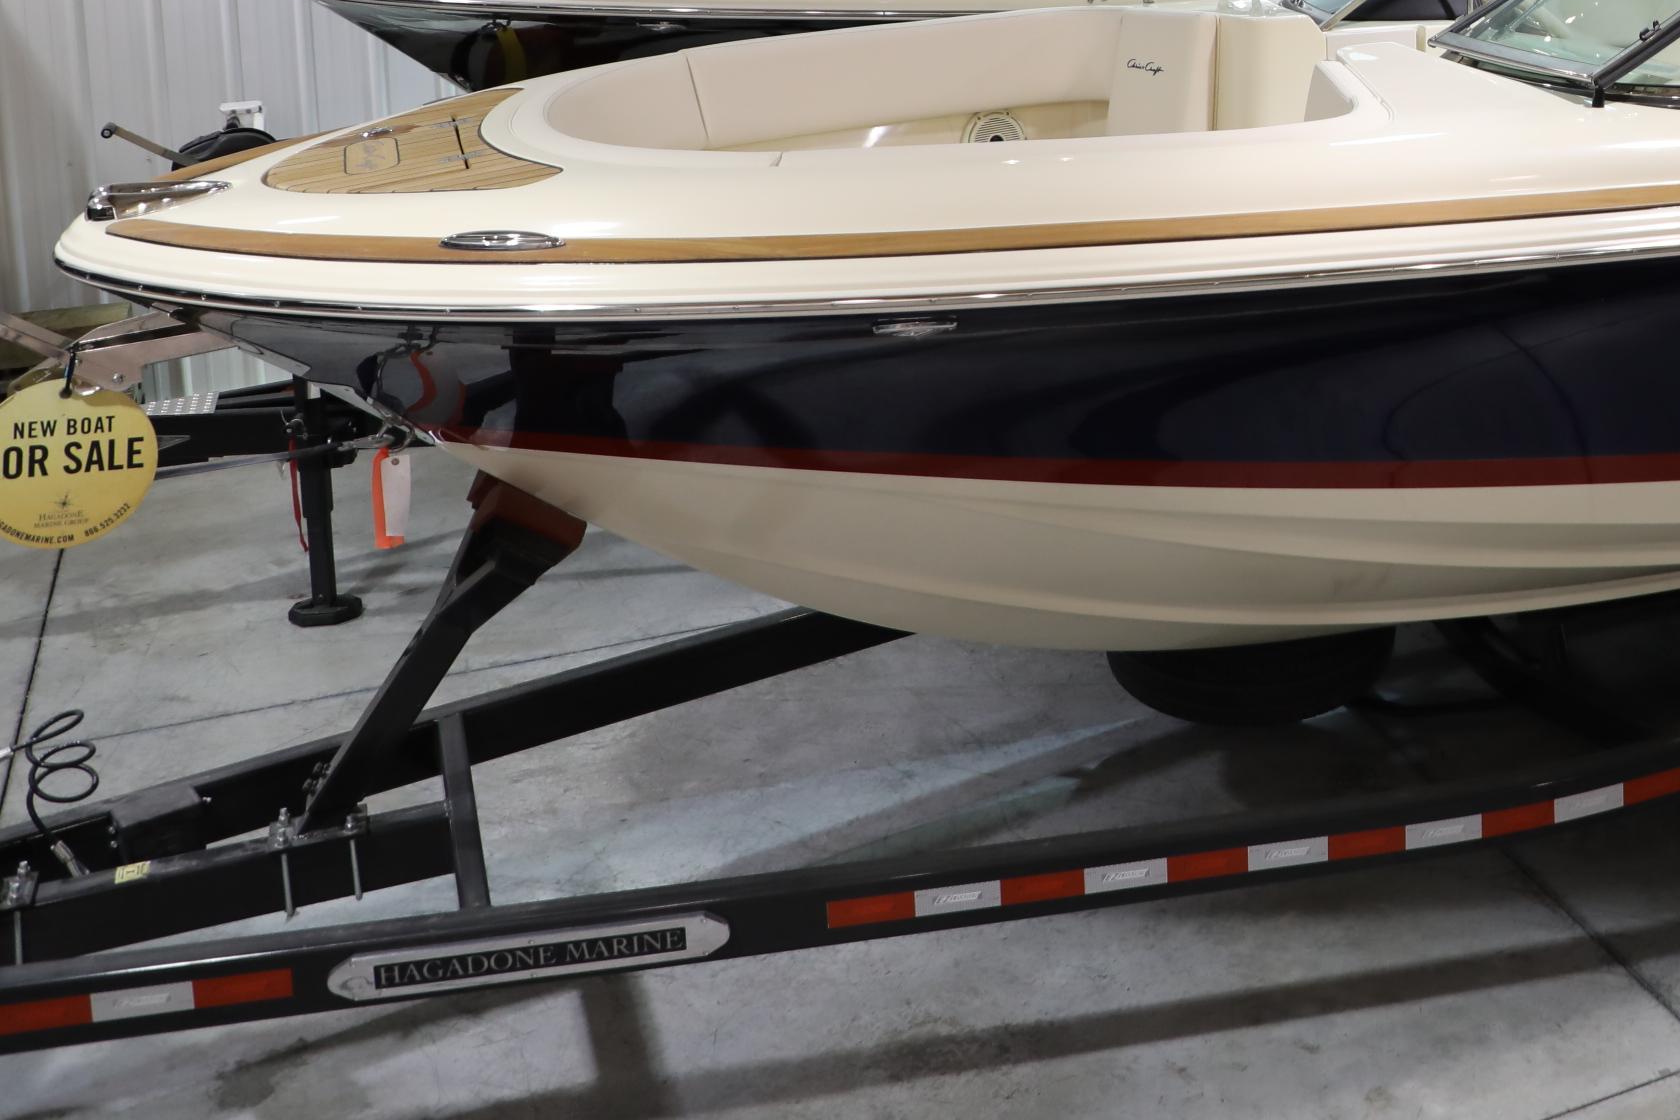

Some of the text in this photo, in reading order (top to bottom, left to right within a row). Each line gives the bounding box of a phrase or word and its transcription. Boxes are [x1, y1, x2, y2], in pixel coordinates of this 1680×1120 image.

[13, 416, 116, 439] NEW BOAT
[63, 436, 144, 474] SALE
[380, 929, 684, 987] HAGADONE MARINE
